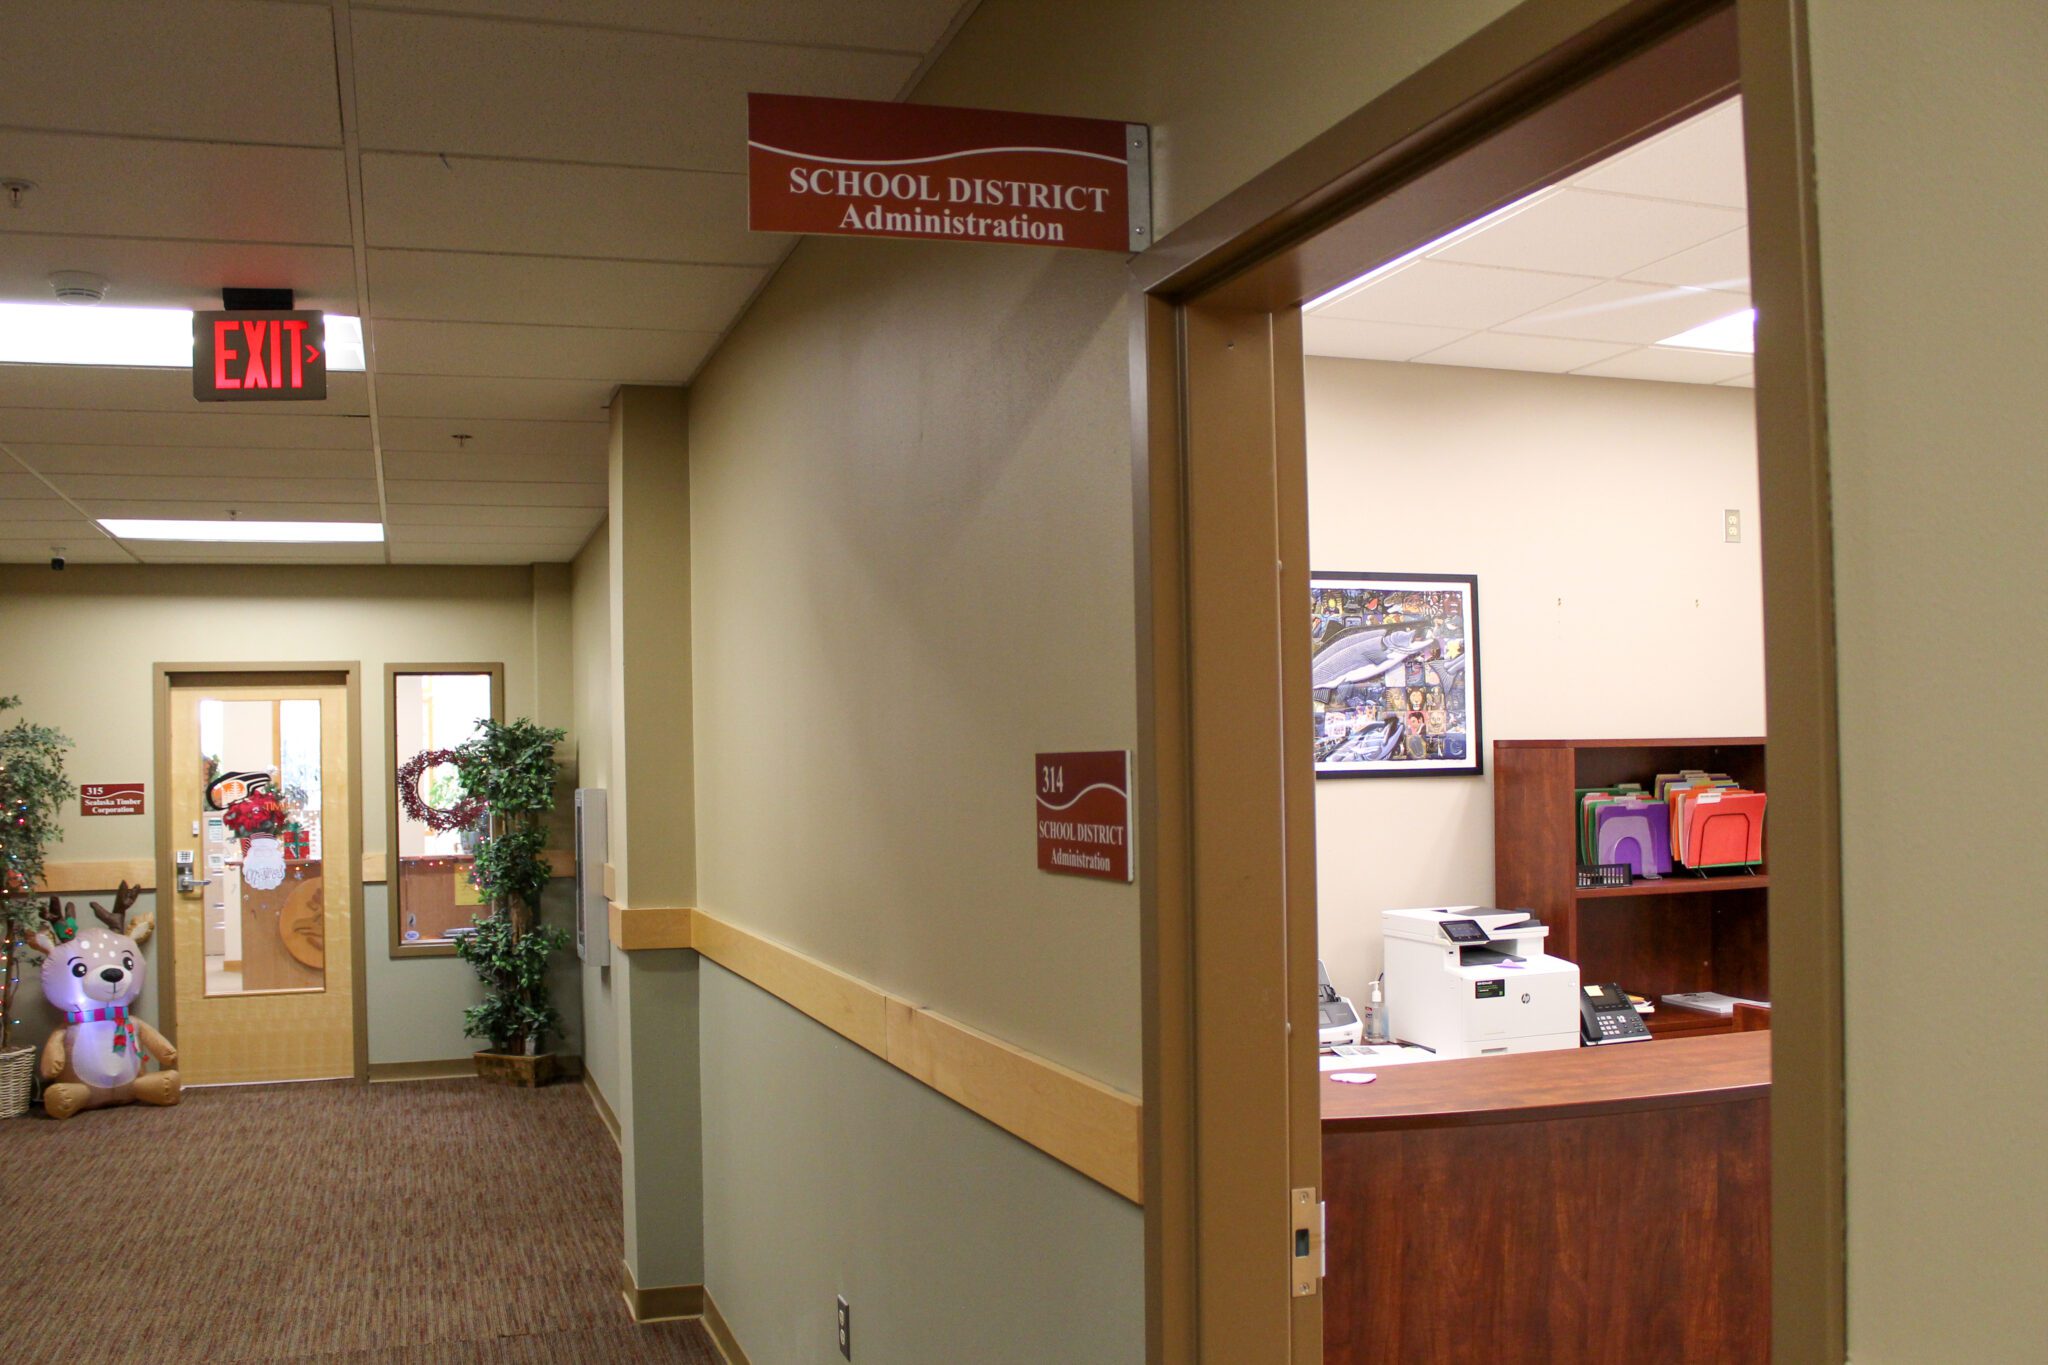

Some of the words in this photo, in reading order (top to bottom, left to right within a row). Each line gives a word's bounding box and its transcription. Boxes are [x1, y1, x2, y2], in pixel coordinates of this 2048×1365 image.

[789, 167, 940, 203] SCHOOL
[948, 177, 1109, 213] DISTRICT
[838, 203, 1065, 241] Administration
[214, 319, 309, 389] EXIT
[86, 787, 104, 795] 315
[1042, 765, 1064, 793] 314
[92, 806, 135, 815] Corporation
[1039, 820, 1076, 840] SCHOOL
[1077, 823, 1124, 846] DISTRICT
[1051, 847, 1111, 872] Administration
